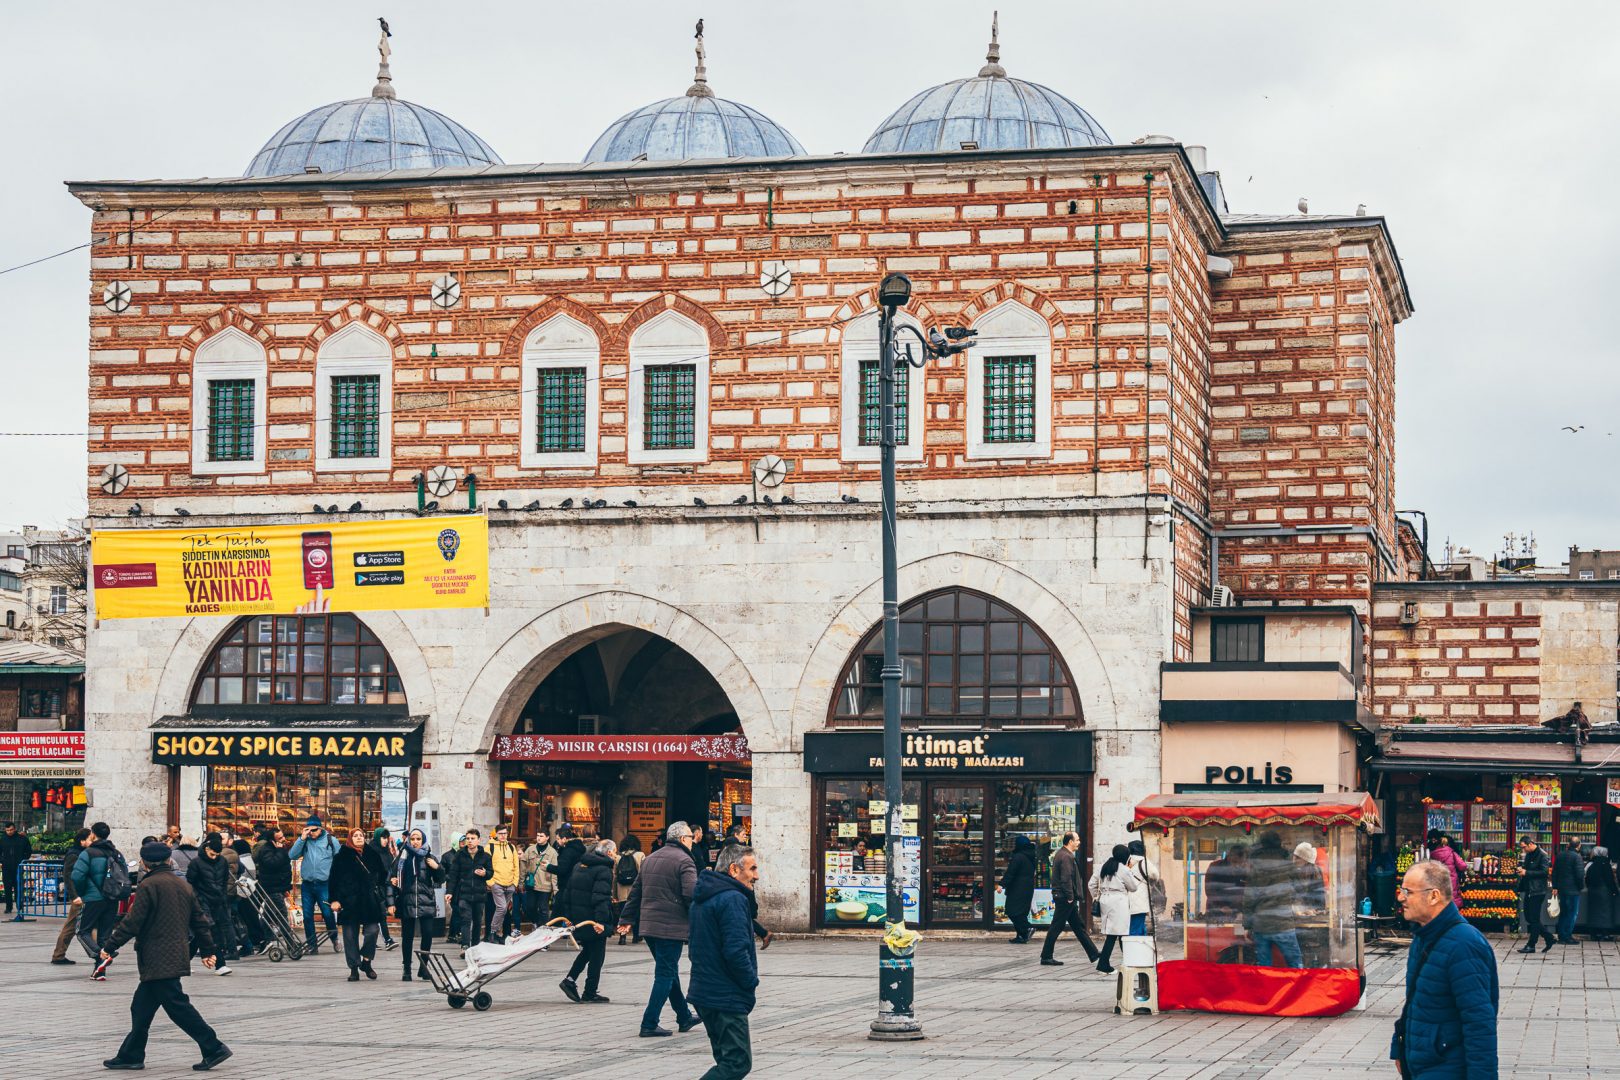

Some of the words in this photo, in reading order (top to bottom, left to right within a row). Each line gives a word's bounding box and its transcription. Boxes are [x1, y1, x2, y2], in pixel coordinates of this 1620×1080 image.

[182, 559, 272, 580] KADINLARIN
[184, 578, 273, 603] YANINDA
[185, 604, 220, 613] KADES
[22, 736, 68, 744] TOHUMCULUK
[70, 736, 78, 744] VE
[158, 736, 234, 756] SHOZY
[240, 736, 302, 756] SPICE
[309, 736, 405, 756] BAZAAR
[558, 742, 595, 752] MISIR
[598, 741, 649, 755] ÇARŞISI
[652, 742, 688, 754] (1664)
[906, 734, 984, 754] itimat
[18, 746, 40, 756] BÖCEK
[869, 755, 918, 767] FAKA
[925, 757, 958, 769] SATIŞ
[964, 755, 1024, 767] MAĞAZASI
[1205, 762, 1293, 784] POLİS
